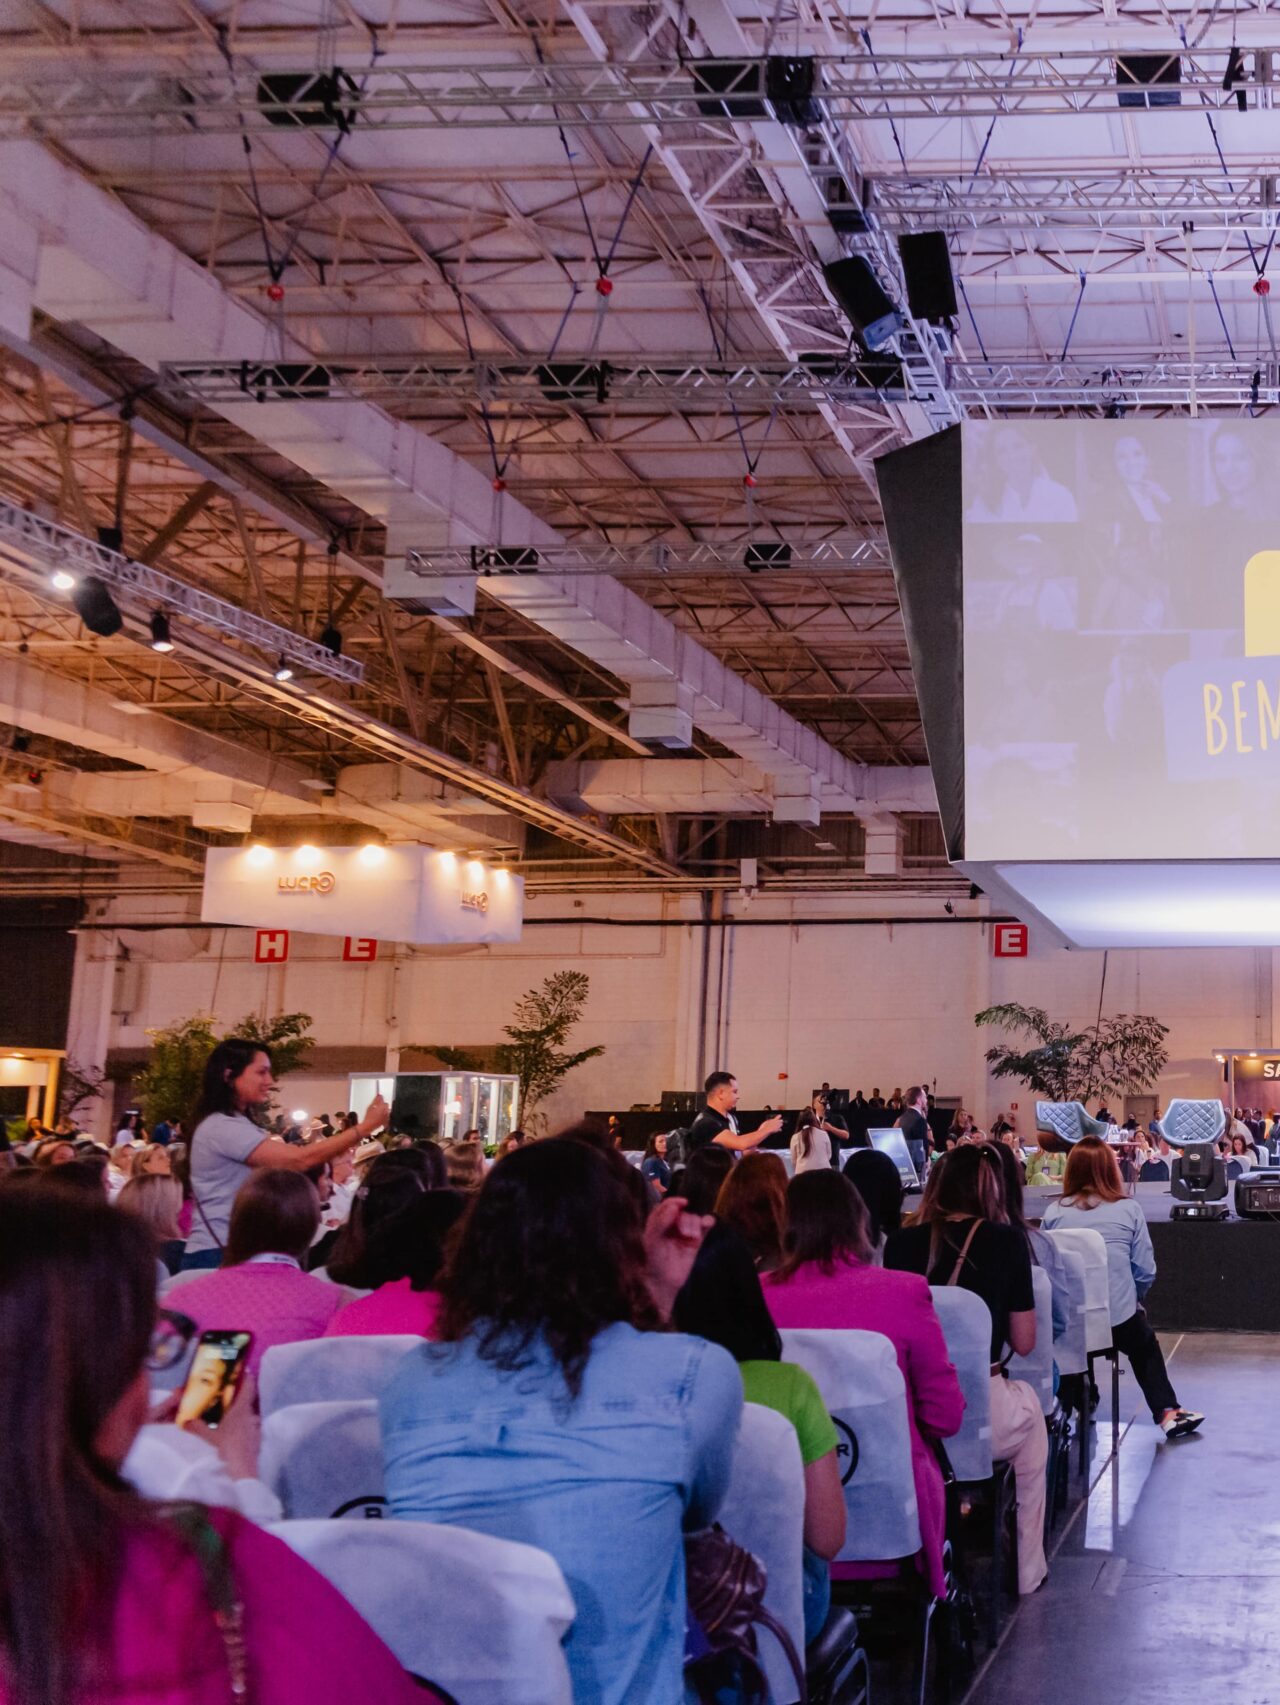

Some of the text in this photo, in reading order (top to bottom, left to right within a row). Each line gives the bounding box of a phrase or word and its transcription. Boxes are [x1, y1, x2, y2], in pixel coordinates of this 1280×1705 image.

[278, 871, 336, 894] LUCRO
[259, 933, 284, 958] H
[1001, 929, 1021, 953] E
